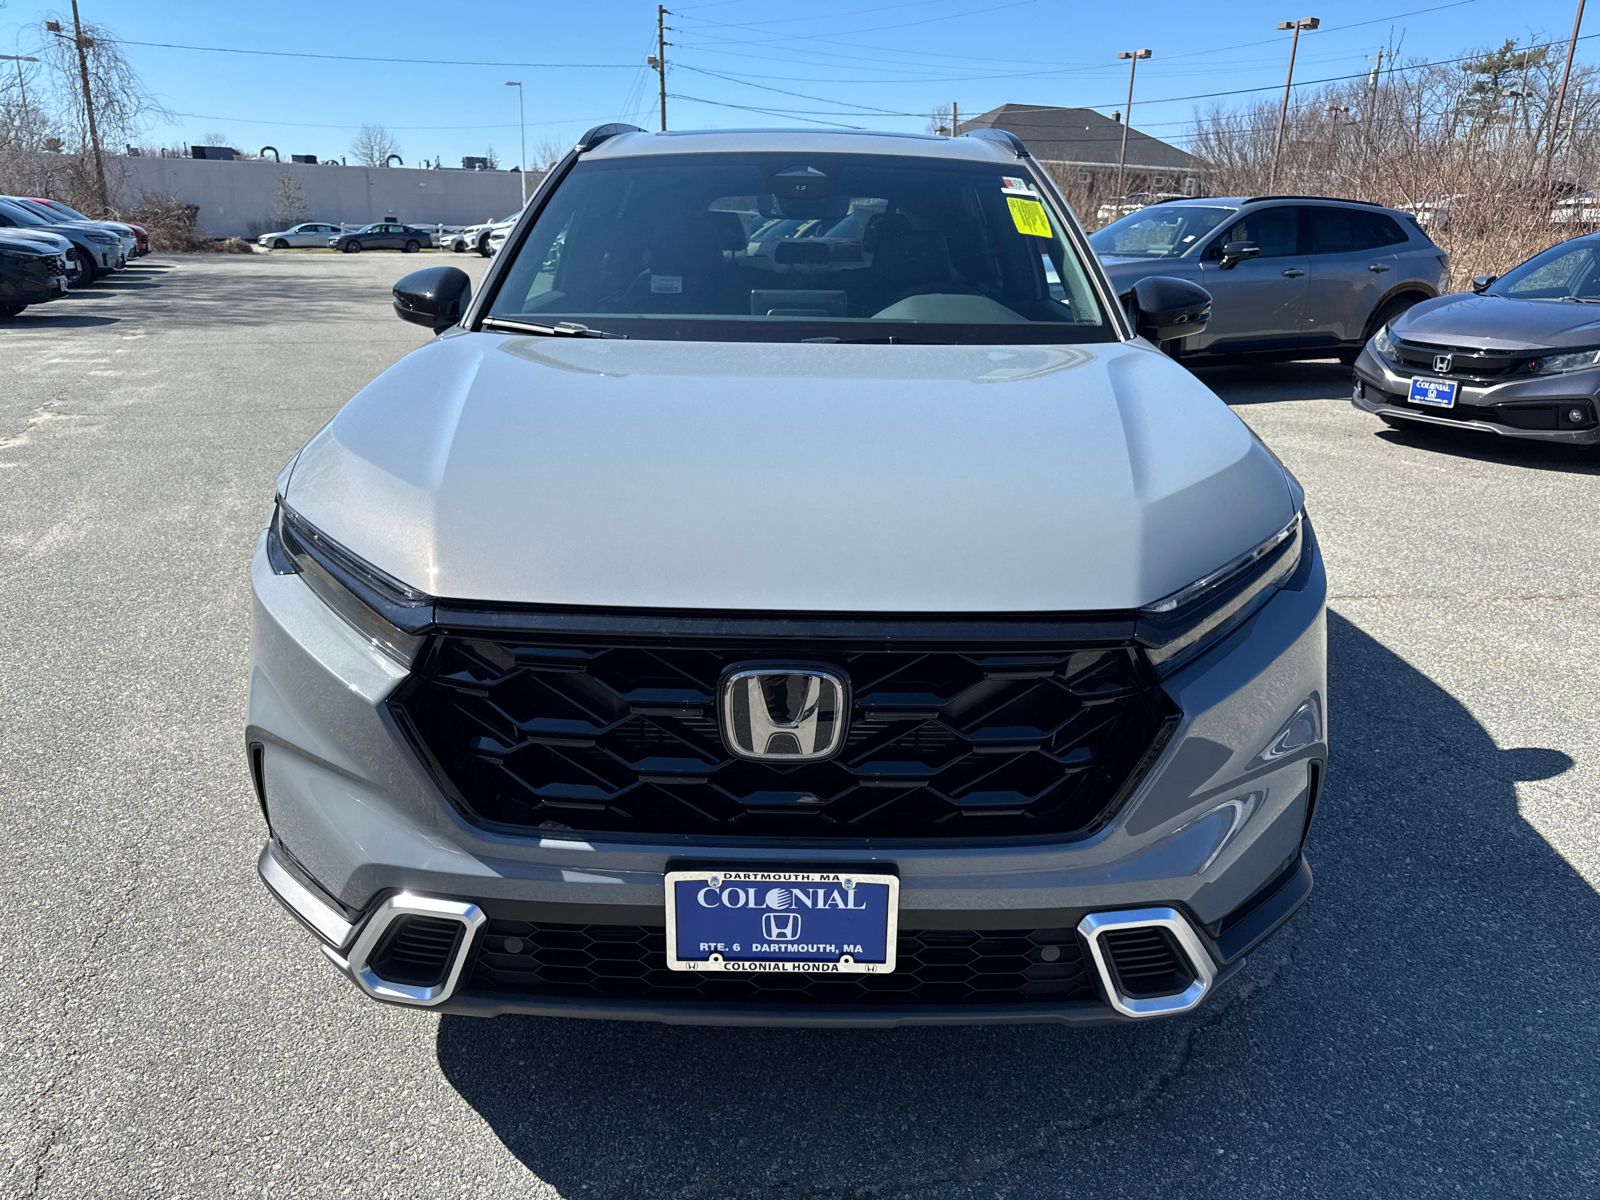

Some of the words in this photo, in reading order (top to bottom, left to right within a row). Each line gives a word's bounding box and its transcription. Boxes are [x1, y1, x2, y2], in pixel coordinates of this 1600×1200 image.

[1416, 381, 1451, 392] COLONIAL
[724, 873, 815, 881] DARTMOUTH,
[697, 887, 866, 910] COLONIAL
[700, 943, 729, 951] RTE.
[732, 943, 741, 951] 6
[752, 943, 839, 954] DARTMOUTH,
[843, 945, 863, 953] MA
[724, 962, 788, 971] COLONIAL
[792, 963, 839, 972] HONDA
